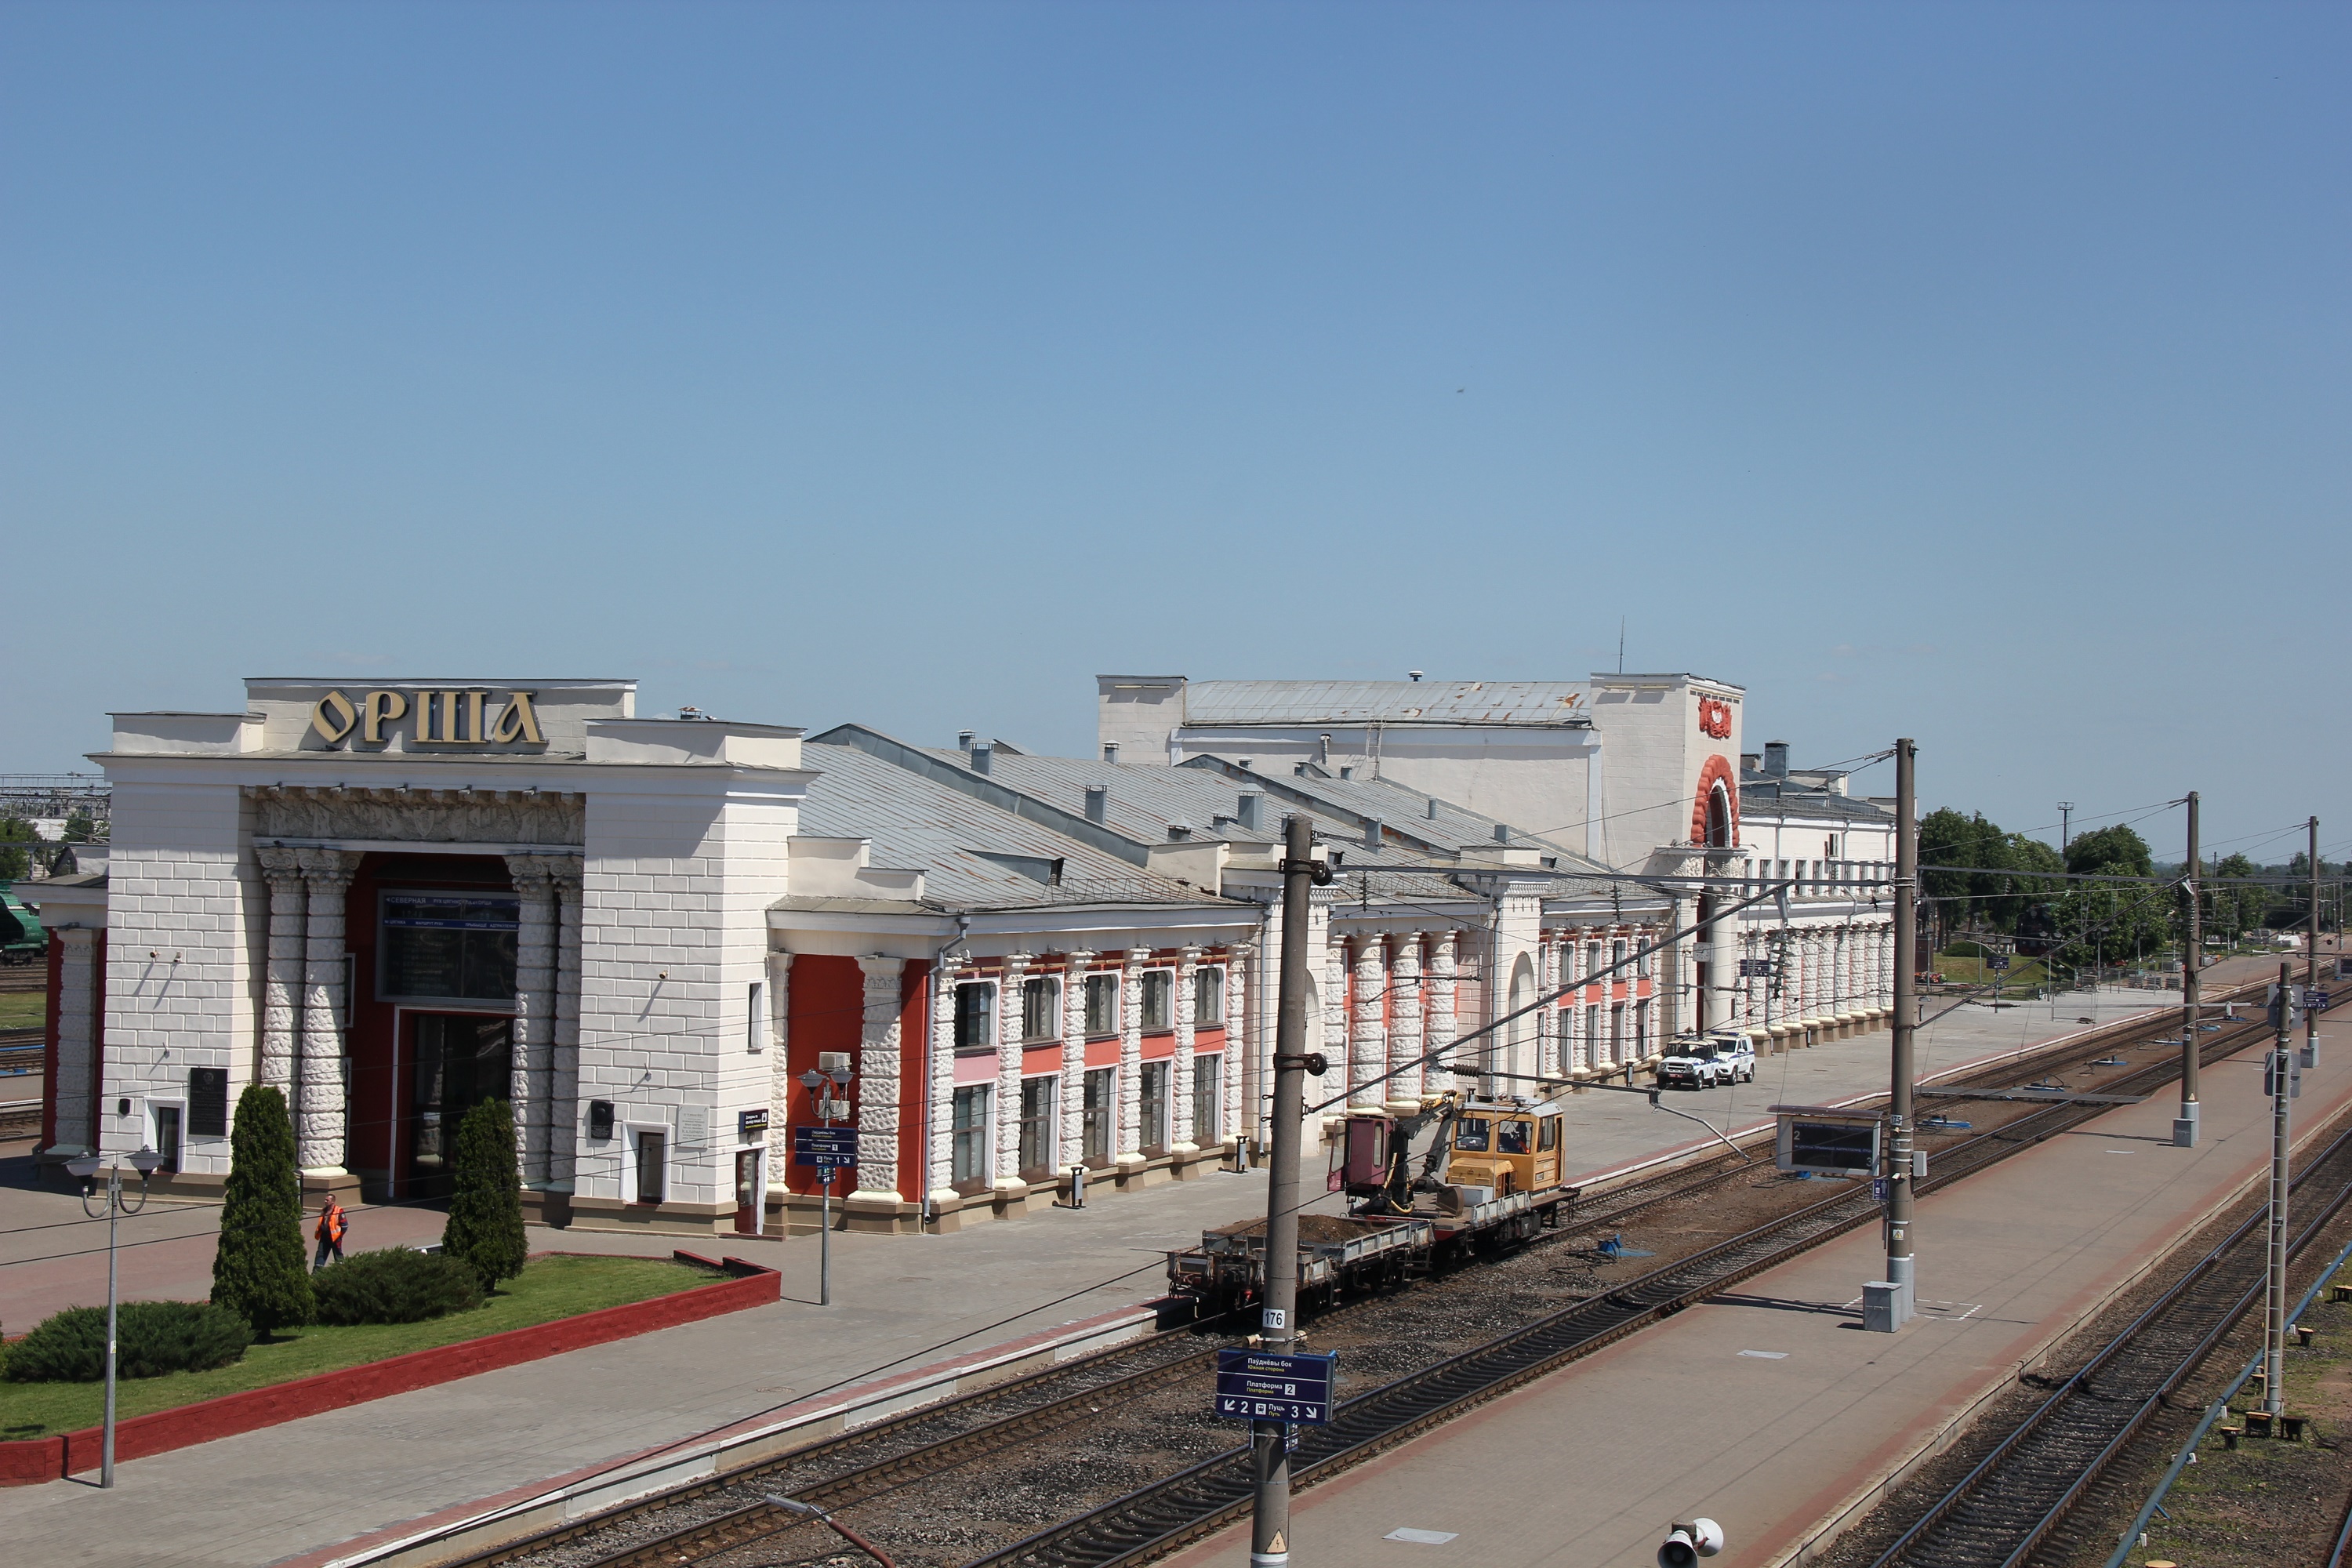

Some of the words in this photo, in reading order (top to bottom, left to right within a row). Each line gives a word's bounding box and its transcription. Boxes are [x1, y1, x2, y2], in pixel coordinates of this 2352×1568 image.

[312, 690, 547, 744] ОРША
[1794, 1131, 1800, 1140] 2
[1866, 1157, 1872, 1167] 3
[1265, 1312, 1283, 1326] 176
[1248, 1358, 1279, 1367] Паўднёвы
[1247, 1381, 1283, 1390] Платформа
[1240, 1401, 1248, 1414] 2
[1269, 1403, 1285, 1412] Пуць
[1291, 1406, 1299, 1418] 3
